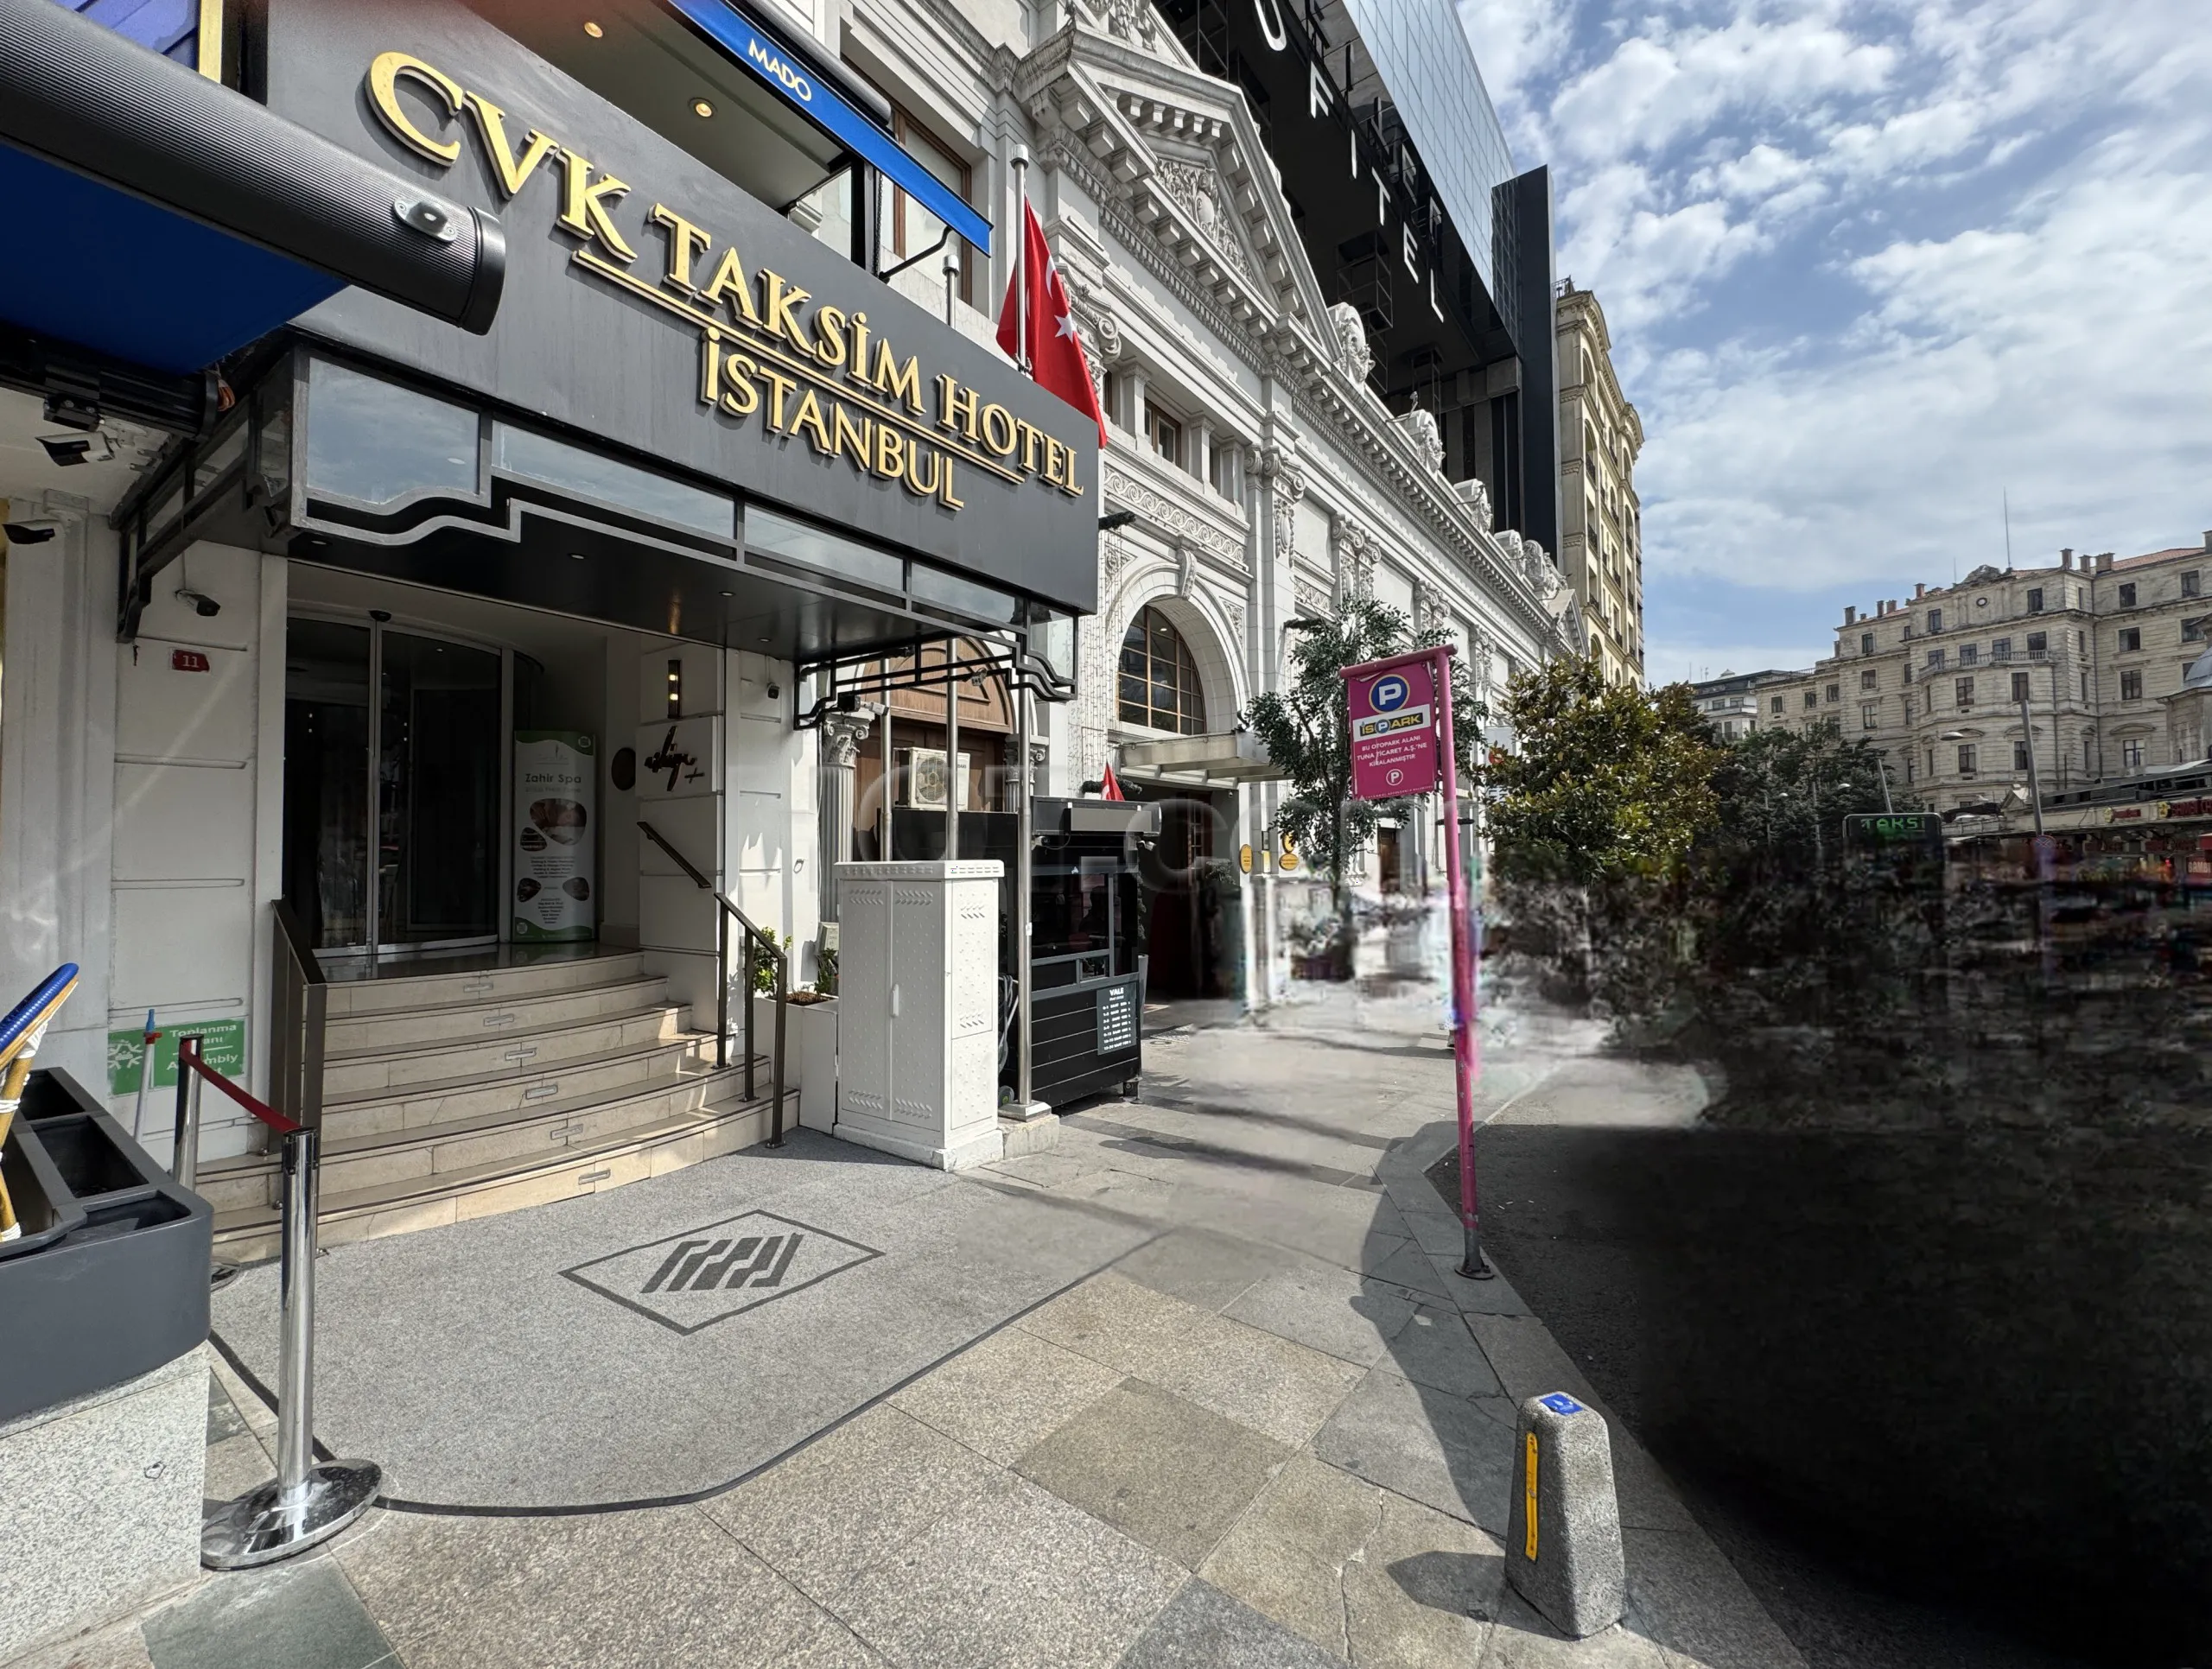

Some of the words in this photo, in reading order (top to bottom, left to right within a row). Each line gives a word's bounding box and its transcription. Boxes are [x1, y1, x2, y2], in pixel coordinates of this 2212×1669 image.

[748, 38, 812, 101] MADO
[366, 50, 638, 264] CVK
[647, 203, 927, 415] TAKSİM
[935, 373, 1085, 498] HOTEL
[699, 325, 966, 511] İSTANBUL
[182, 655, 199, 668] 11
[1371, 739, 1401, 749] OTOPARK
[1401, 735, 1421, 744] ALANI
[1357, 752, 1375, 761] TUNA
[525, 773, 554, 783] Zahir
[558, 774, 582, 784] Spa
[1109, 987, 1124, 996] VALE
